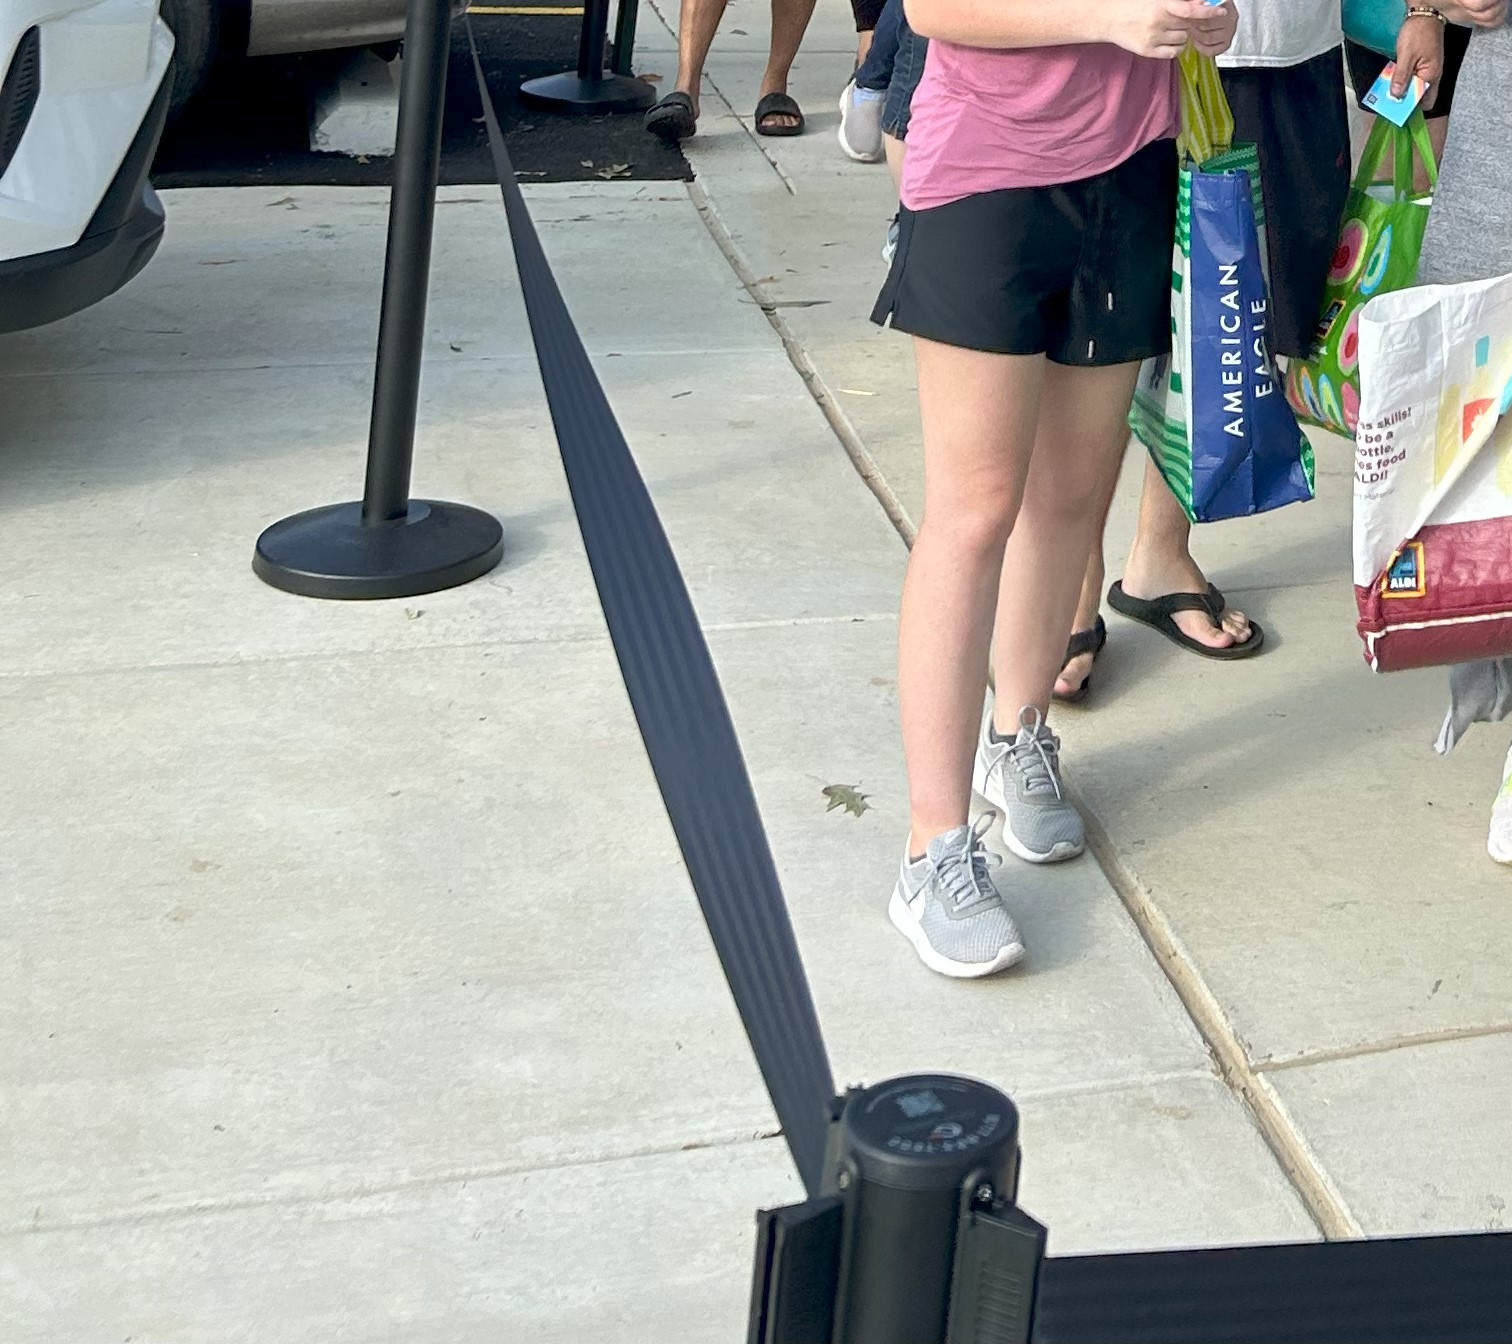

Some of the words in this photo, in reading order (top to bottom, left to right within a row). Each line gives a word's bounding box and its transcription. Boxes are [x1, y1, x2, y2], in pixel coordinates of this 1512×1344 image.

[1218, 264, 1245, 438] AMERICAN
[1377, 406, 1412, 429] skills!
[1377, 448, 1406, 470] food
[1390, 576, 1417, 590] ALDI
